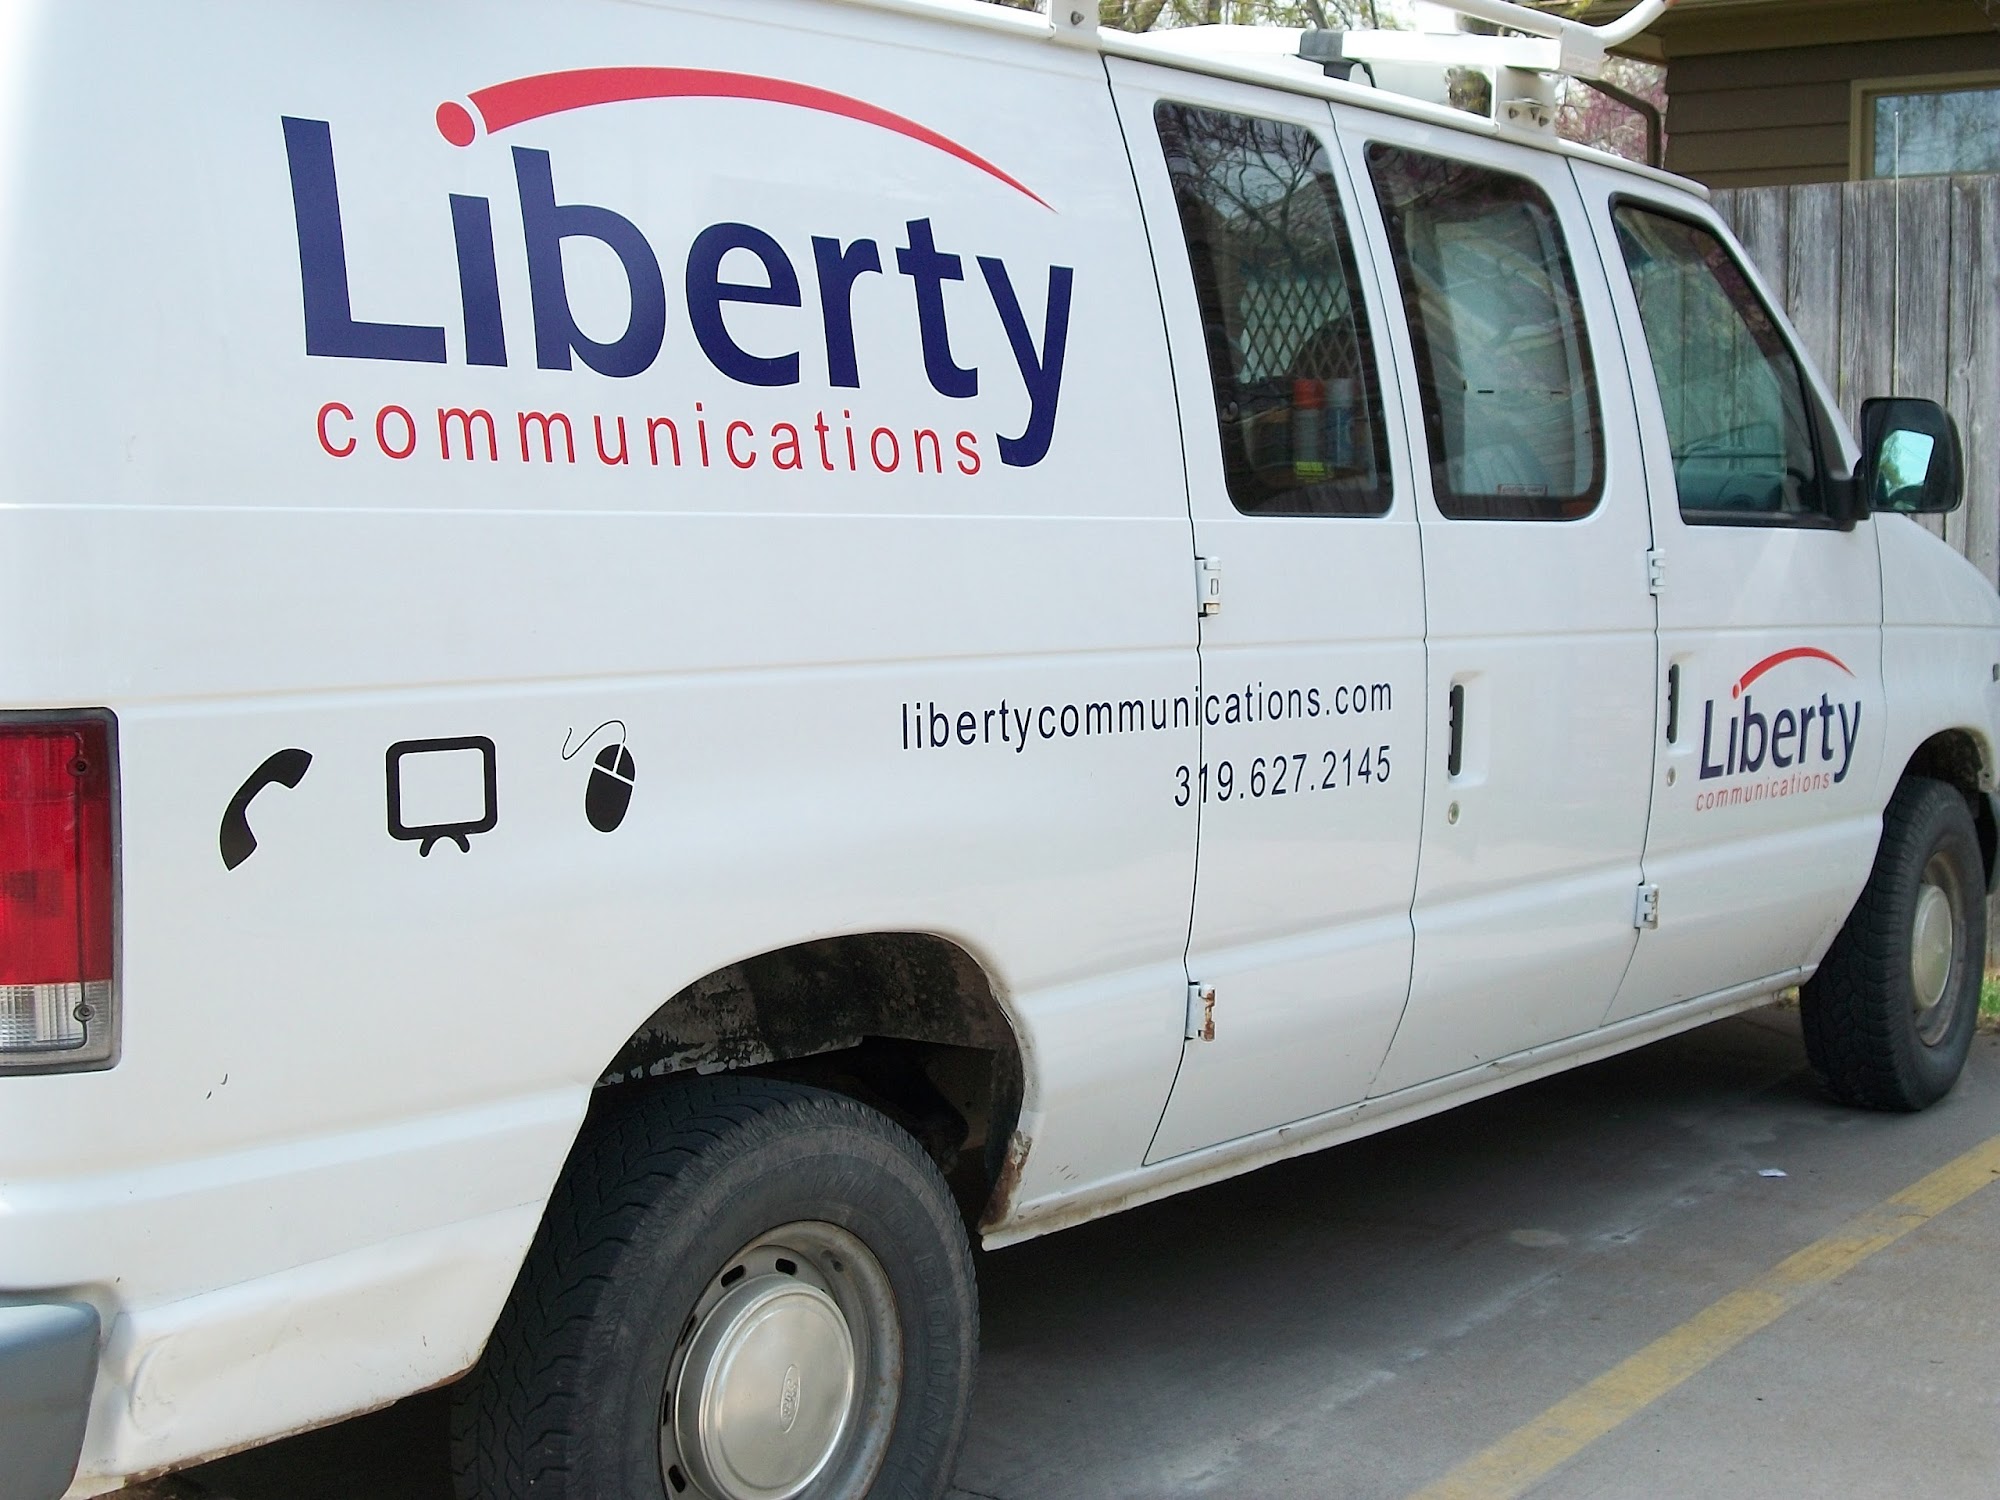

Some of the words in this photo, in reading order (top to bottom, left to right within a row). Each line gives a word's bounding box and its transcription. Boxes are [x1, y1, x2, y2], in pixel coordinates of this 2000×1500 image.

[281, 101, 1074, 468] Liberty
[316, 401, 982, 476] communications
[902, 681, 1392, 754] libertycommunications.com
[1699, 684, 1861, 784] Liberty
[1174, 745, 1390, 807] 319.627.2145
[1696, 773, 1830, 812] communications
